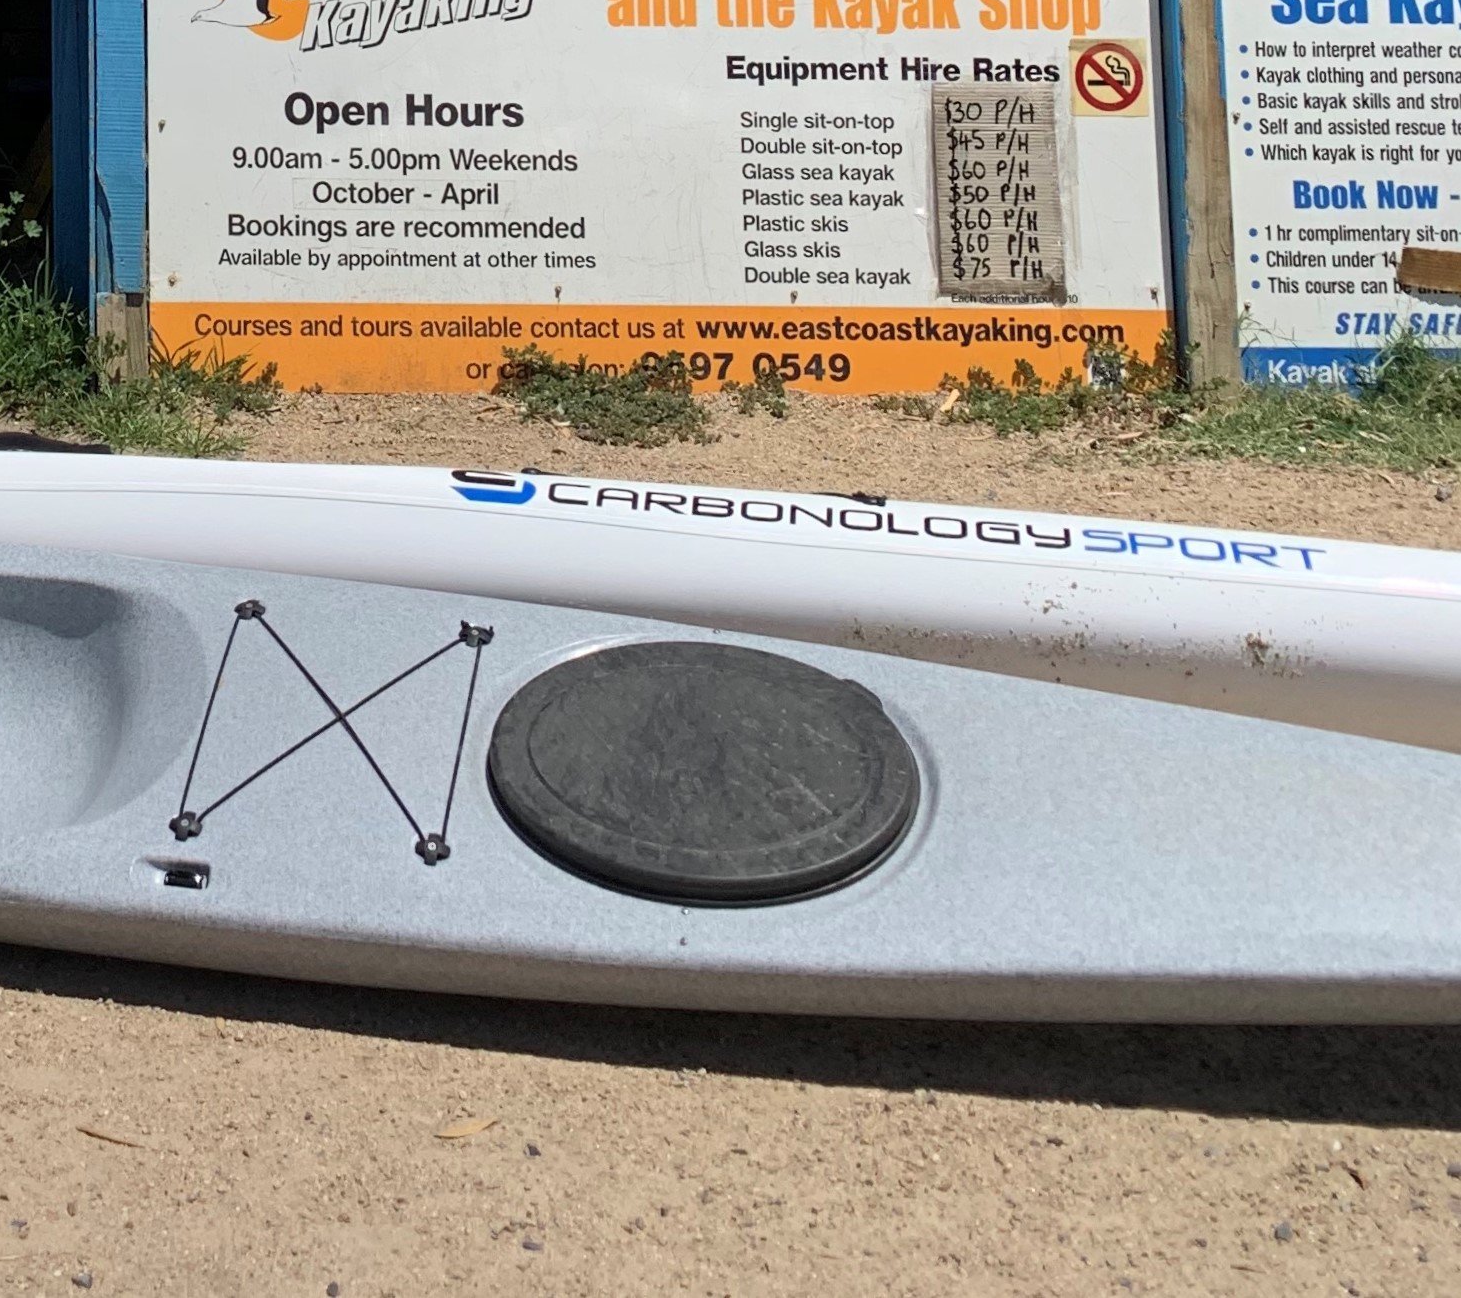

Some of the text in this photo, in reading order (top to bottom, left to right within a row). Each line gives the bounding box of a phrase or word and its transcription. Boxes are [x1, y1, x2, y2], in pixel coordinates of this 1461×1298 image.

[1255, 40, 1288, 58] How
[1292, 40, 1307, 58] to
[1312, 40, 1376, 62] interpret
[1381, 41, 1443, 59] weather
[726, 55, 1061, 87] Equipment Hire Rates
[1256, 66, 1302, 87] Kayak
[1306, 66, 1365, 88] clothing
[1369, 67, 1398, 84] and
[284, 91, 525, 135] Open Hours
[945, 96, 1034, 128] $30 P/H
[1257, 92, 1298, 110] Basic
[1303, 92, 1347, 113] kayak
[1352, 92, 1391, 110] skills
[1396, 92, 1425, 110] and
[740, 111, 895, 134] Single sit-on-top
[1259, 117, 1289, 135] Self
[1294, 118, 1323, 135] and
[1327, 118, 1391, 136] assisted
[1395, 122, 1446, 136] rescue
[740, 137, 903, 160] Double sit-on-top
[947, 126, 1029, 155] $45 P/H
[232, 146, 323, 169] 9.00am
[349, 147, 441, 176] 5.00pm
[448, 148, 578, 172] Weekends
[1260, 143, 1308, 161] Which
[1312, 143, 1357, 165] kayak
[1361, 144, 1375, 161] is
[1379, 144, 1415, 166] right
[1419, 144, 1440, 162] for
[741, 162, 895, 186] Glass sea kayak
[948, 156, 1029, 184] $60 P/H
[312, 180, 415, 205] October
[440, 182, 499, 211] April
[742, 188, 905, 212] Plastic sea kayak
[949, 183, 1036, 205] $50 P/H
[1292, 179, 1368, 210] Book
[1376, 180, 1439, 210] Now
[228, 213, 586, 243] Bookings are recommended
[743, 214, 849, 233] Plastic skis
[950, 207, 1038, 232] $60 P/H
[952, 231, 1039, 257] $60 P/H
[1264, 224, 1272, 241] 1
[1276, 224, 1292, 242] hr
[1298, 224, 1411, 246] complimentary
[218, 248, 597, 271] Available by appointment at other times
[744, 240, 841, 259] Glass skis
[1266, 250, 1327, 268] Children
[1331, 250, 1376, 268] under
[744, 266, 911, 290] Double sea kayak
[1267, 276, 1300, 294] This
[1305, 280, 1355, 295] course
[1360, 280, 1388, 295] can
[951, 293, 976, 303] Each
[194, 313, 1125, 347] Courses and tours available contact us at www.eastcoastkayaking.com
[1335, 312, 1399, 335] STAY
[465, 362, 493, 380] or
